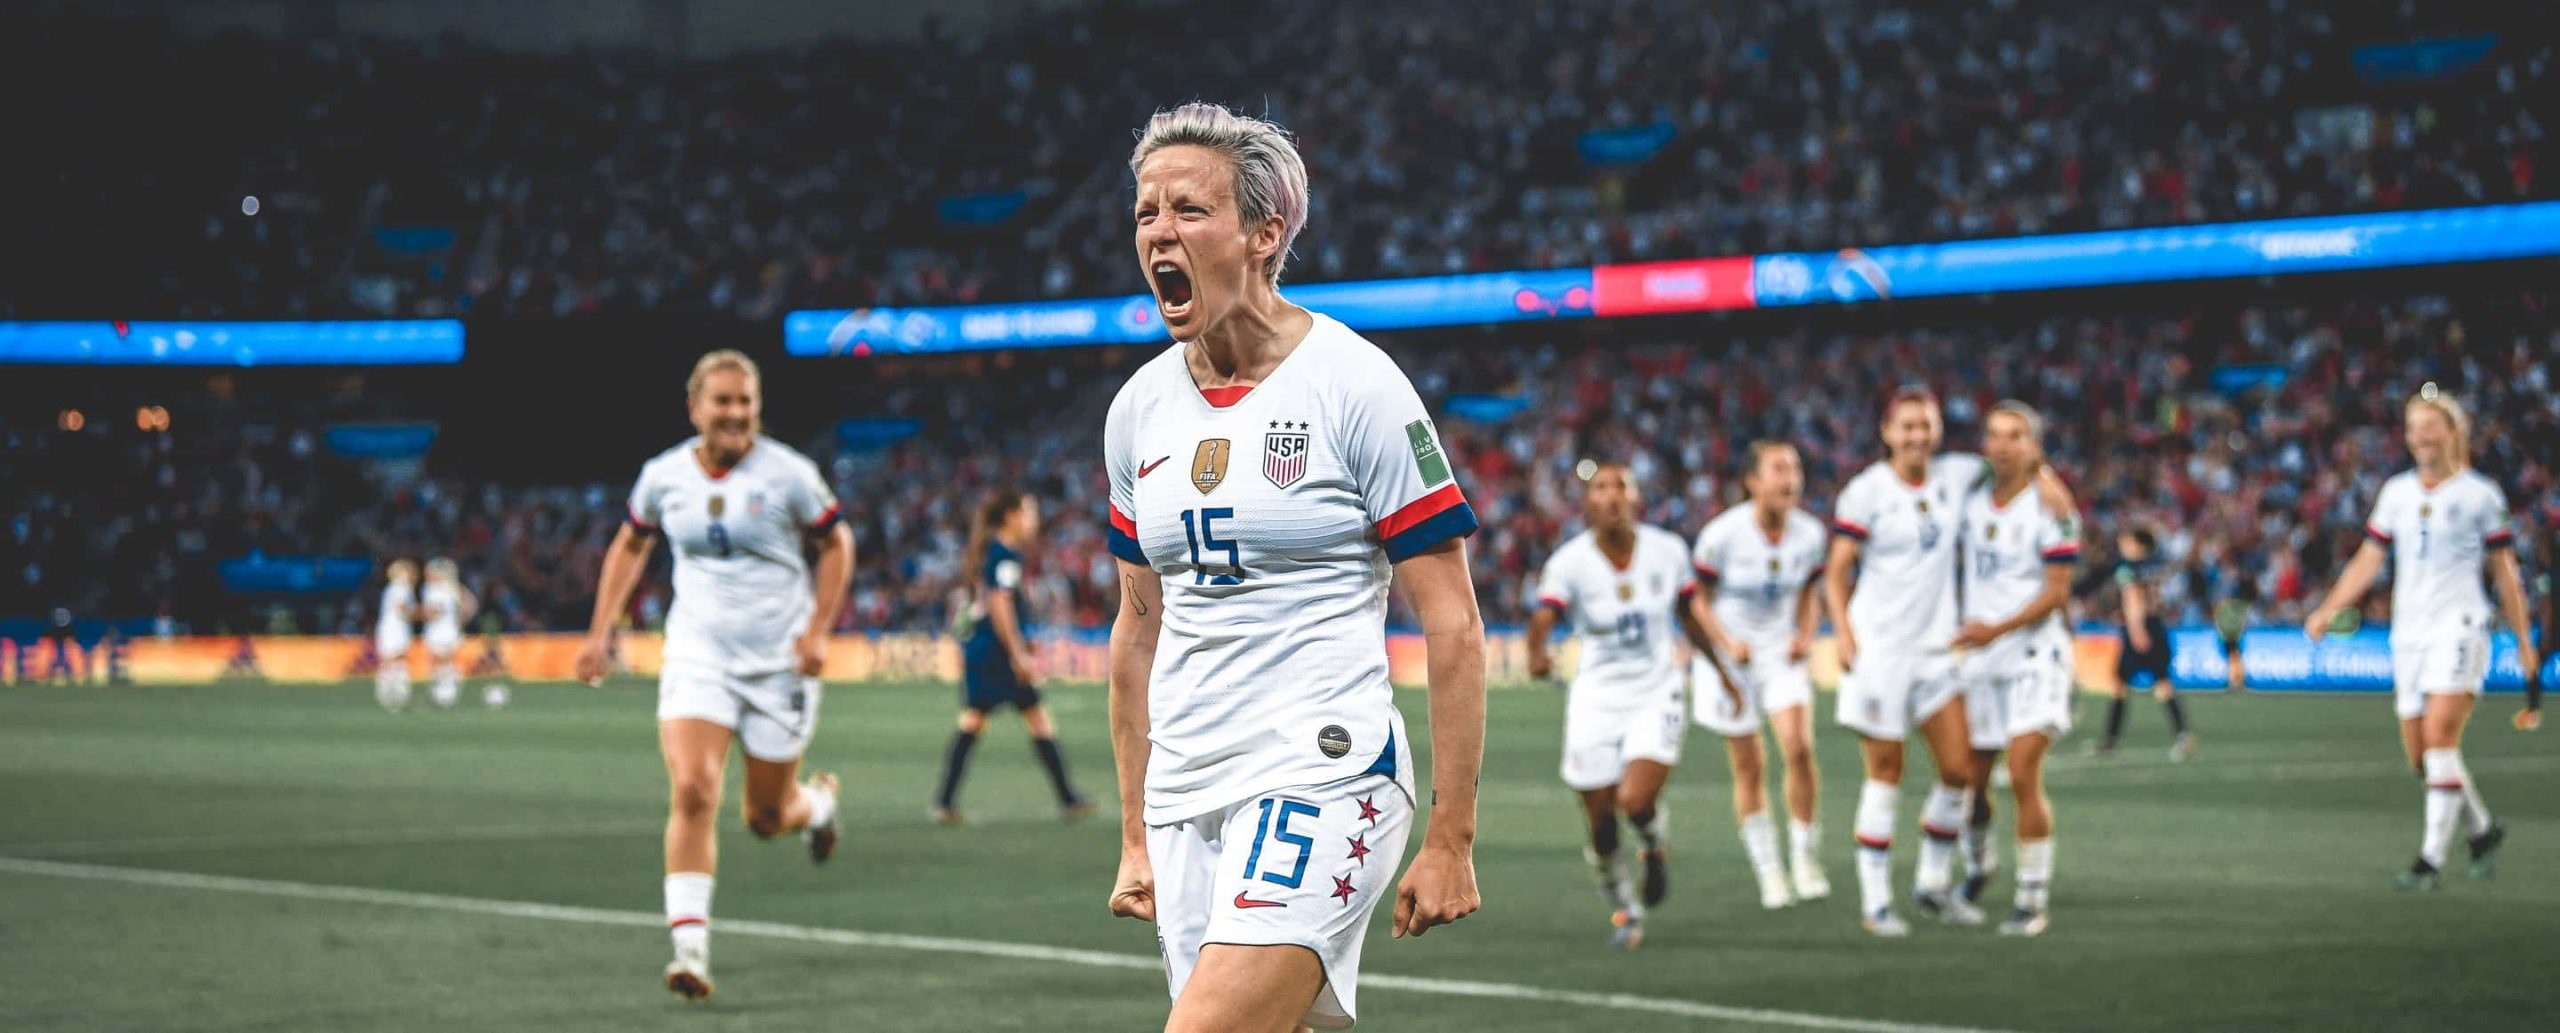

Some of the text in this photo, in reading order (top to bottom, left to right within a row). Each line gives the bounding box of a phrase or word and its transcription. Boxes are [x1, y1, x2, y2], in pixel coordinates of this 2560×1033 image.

[1269, 436, 1305, 457] USA
[1180, 507, 1246, 586] 15
[1243, 798, 1321, 889] 15
